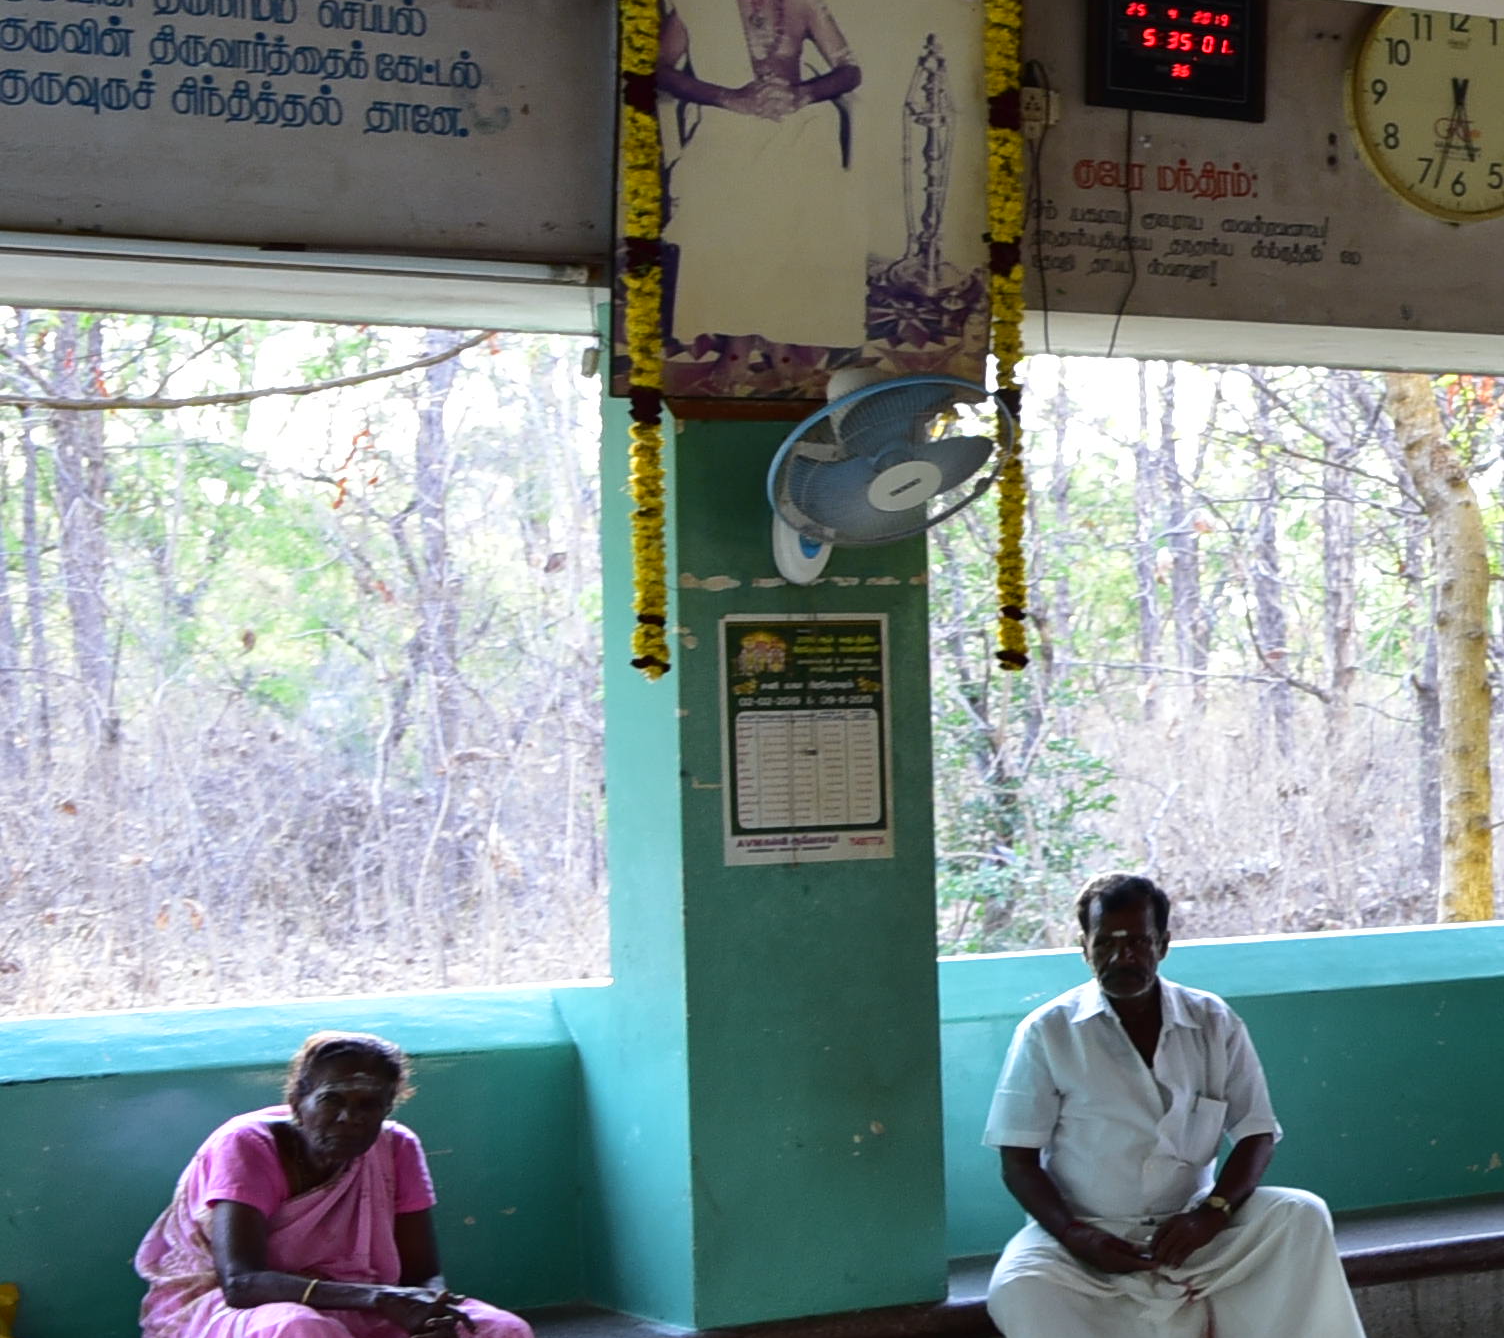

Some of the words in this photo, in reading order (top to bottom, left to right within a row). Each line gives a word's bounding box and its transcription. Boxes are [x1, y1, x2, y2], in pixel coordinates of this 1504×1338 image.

[1412, 13, 1433, 41] 11
[1490, 19, 1499, 46] 1
[0, 15, 135, 58] குருவின்
[149, 25, 369, 80] திருவார்த்தைக்
[376, 50, 482, 90] கேட்டல்
[1385, 38, 1411, 66] 10
[0, 68, 157, 115] குருவுருச்
[172, 74, 343, 129] சிந்தித்தல்
[362, 100, 470, 138] தானே.
[1371, 79, 1388, 105] 9
[1383, 122, 1400, 150] 8
[1418, 157, 1435, 185] 7
[1451, 172, 1466, 197] 6
[1488, 163, 1504, 190] 5
